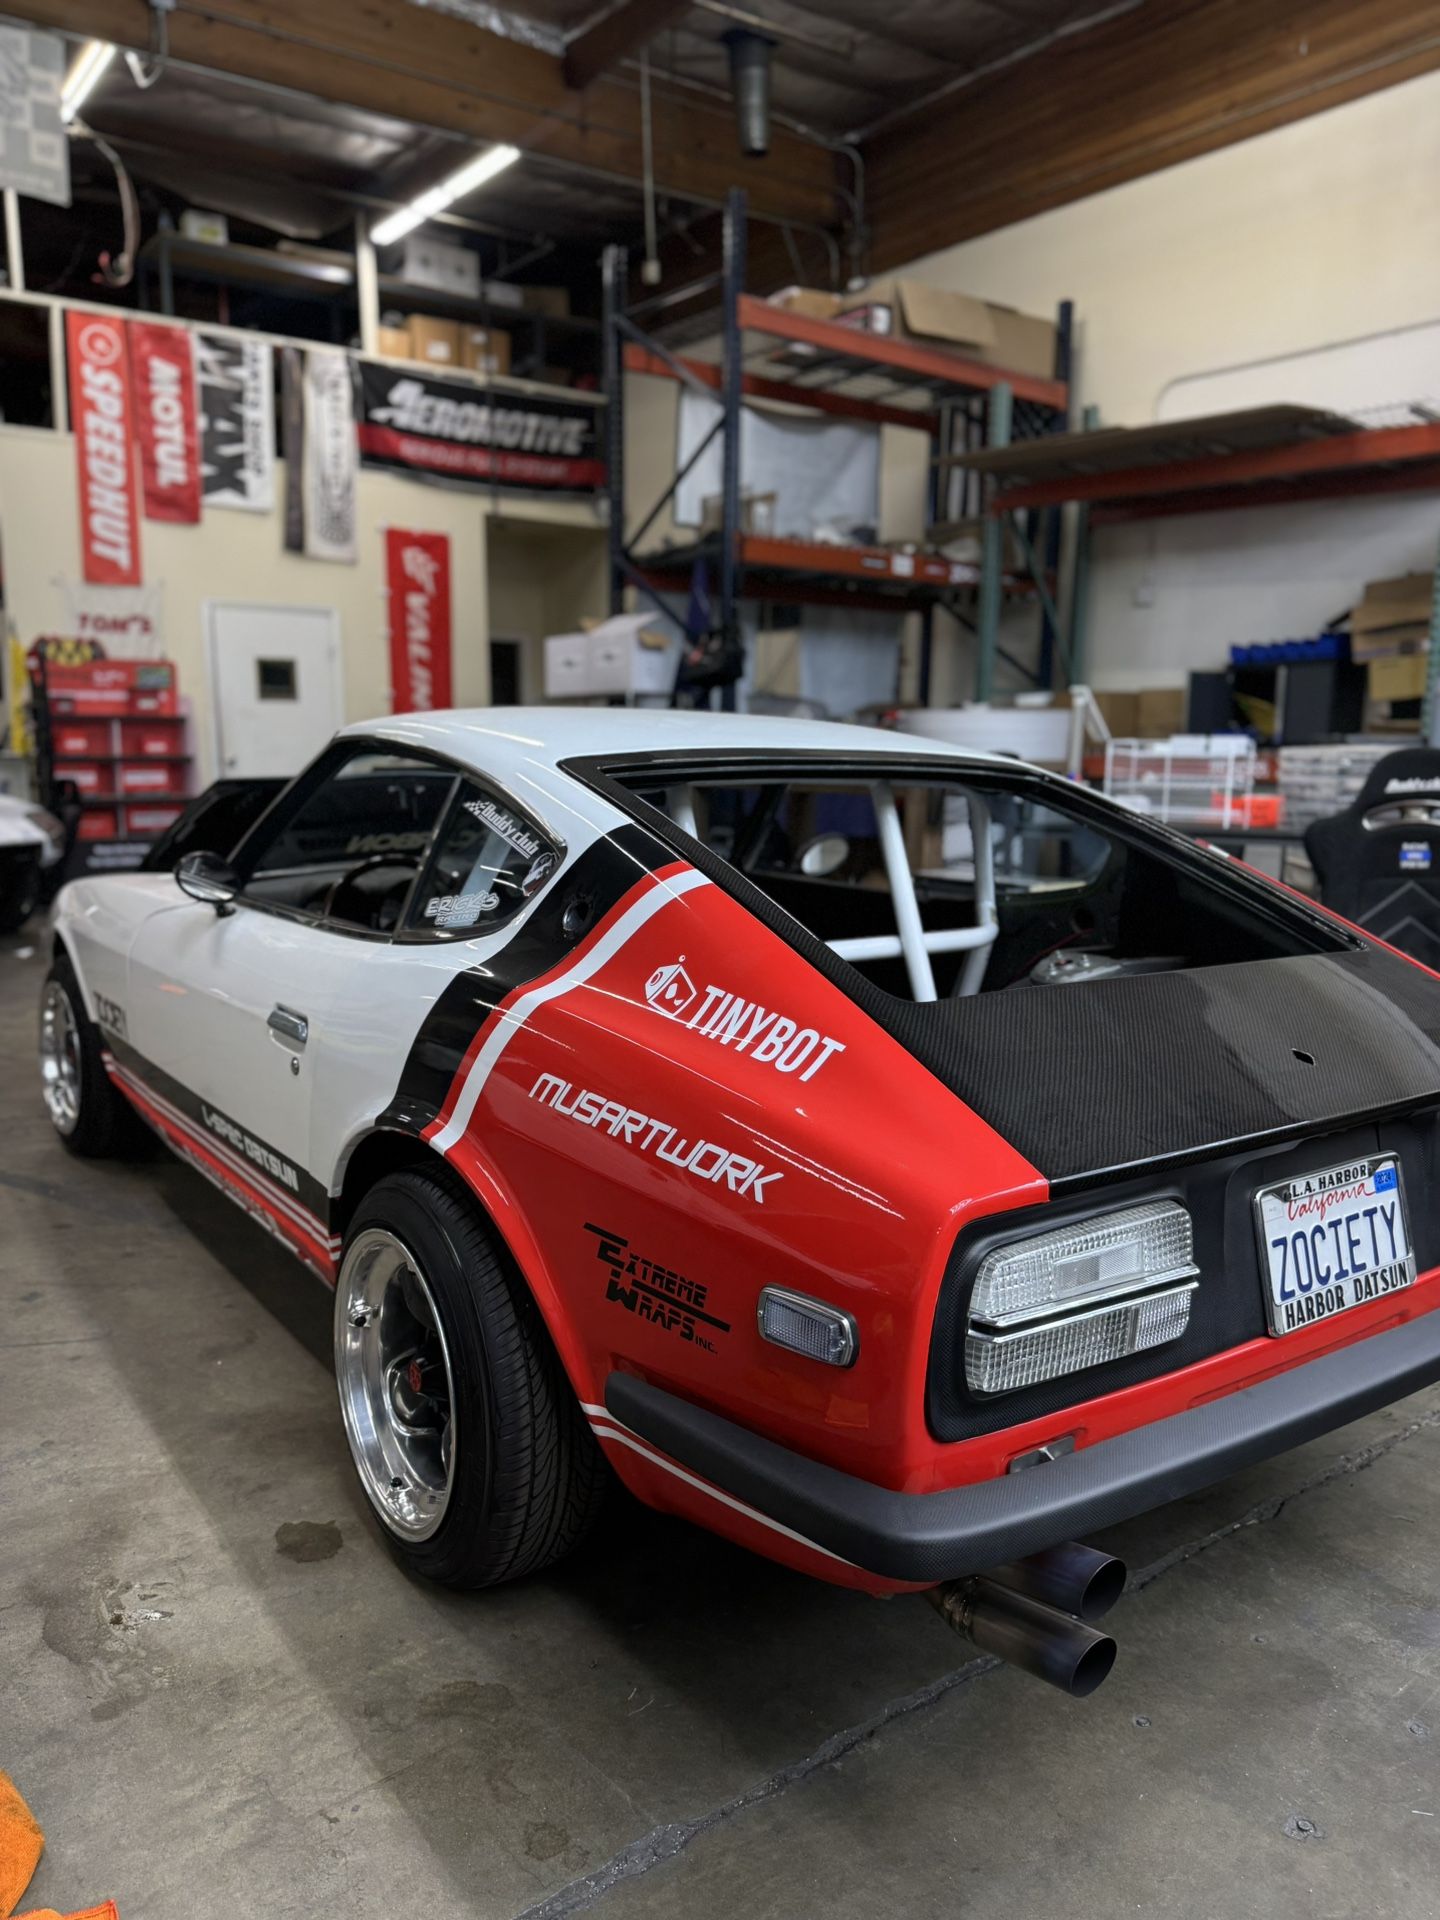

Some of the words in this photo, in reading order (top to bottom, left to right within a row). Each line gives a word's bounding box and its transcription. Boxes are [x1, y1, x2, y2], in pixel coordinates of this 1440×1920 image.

[149, 355, 187, 488] MOTUL
[369, 379, 590, 456] AEROMOTIVE
[80, 364, 131, 573] SPEEDHUT
[406, 591, 433, 711] VALIN
[686, 985, 847, 1082] TINYBOT
[528, 1072, 784, 1203] MUSARTWORK
[1292, 1181, 1316, 1197] L.A.
[1318, 1164, 1367, 1189] HARBOR
[1286, 1182, 1377, 1221] California
[584, 1222, 708, 1309] EXTREME
[1272, 1201, 1398, 1301] ZOCIETY
[1284, 1284, 1346, 1330] HARBOR
[1353, 1261, 1408, 1301] DATSUN
[605, 1269, 696, 1342] WRAPS
[695, 1335, 719, 1355] INC.
